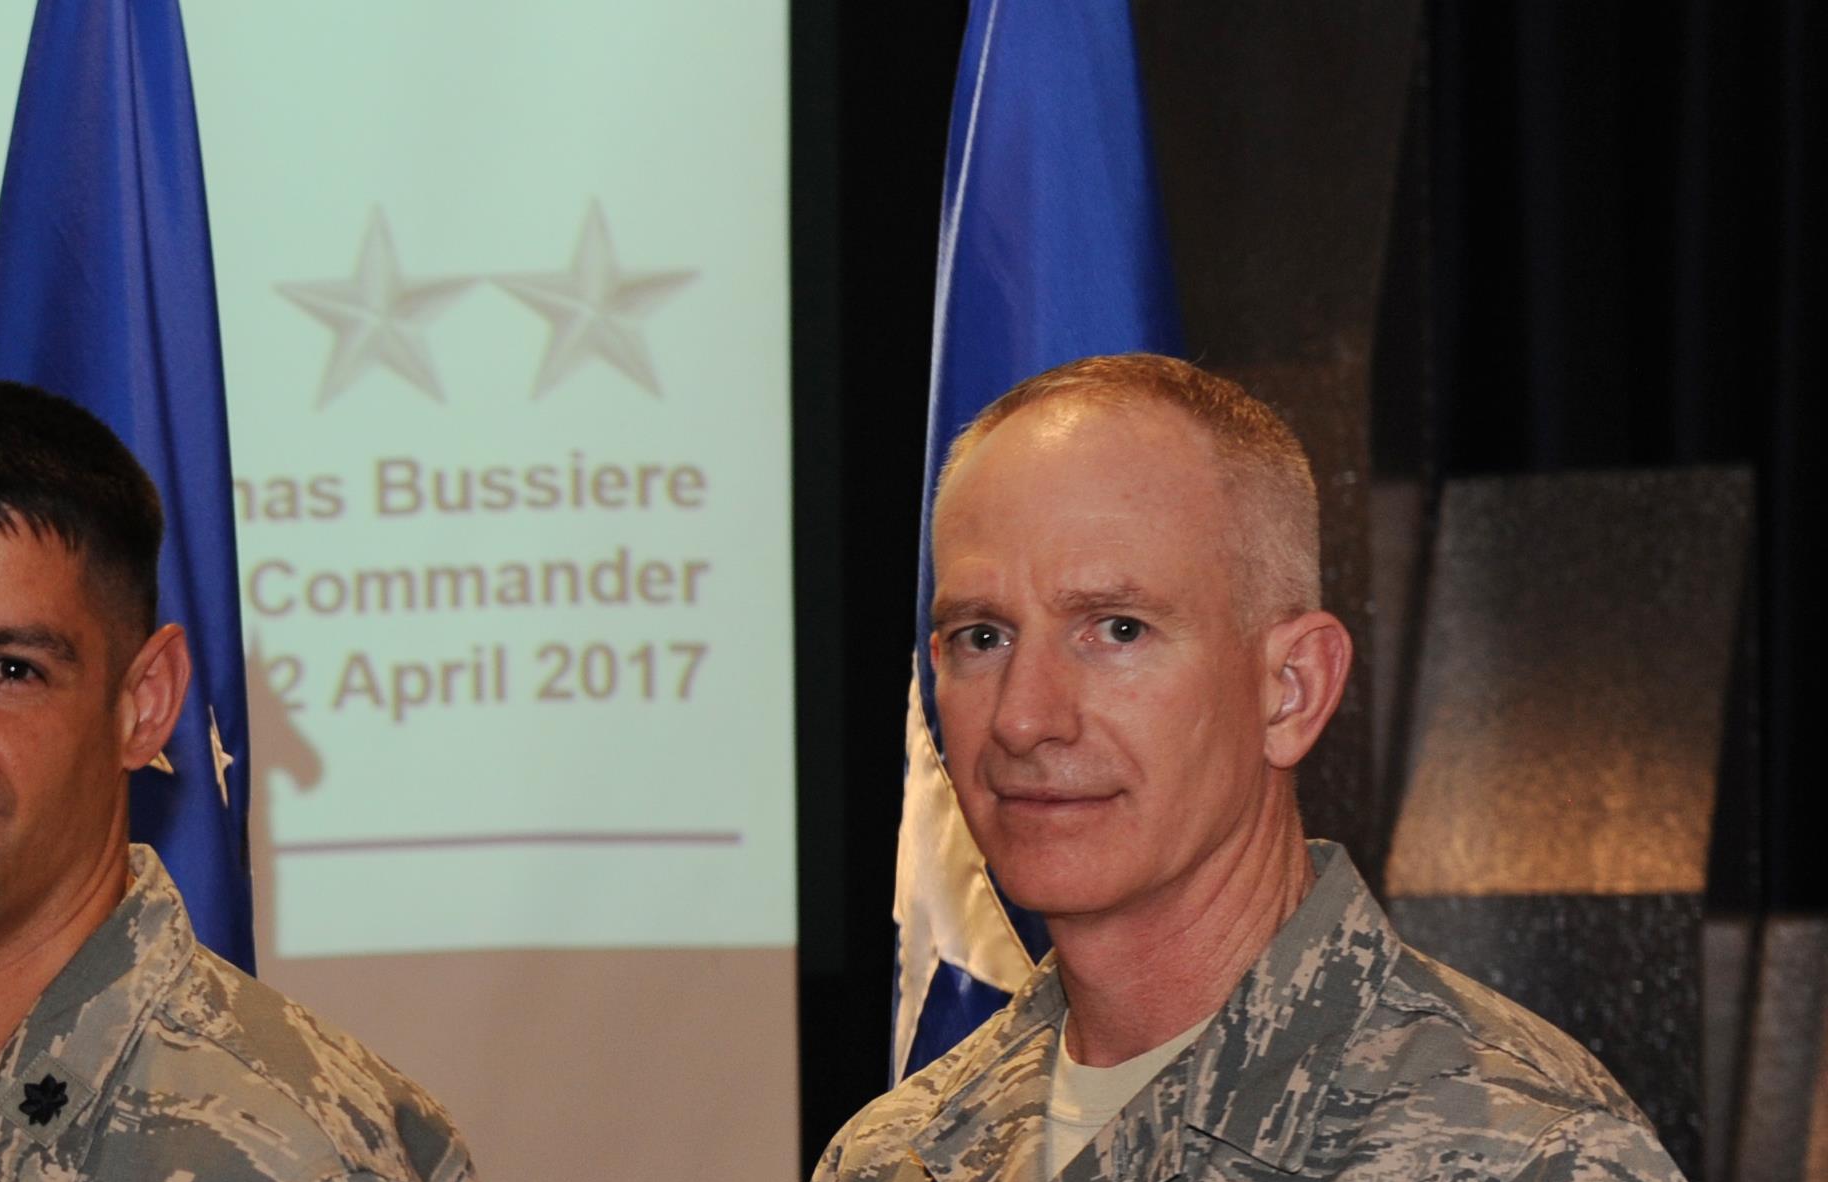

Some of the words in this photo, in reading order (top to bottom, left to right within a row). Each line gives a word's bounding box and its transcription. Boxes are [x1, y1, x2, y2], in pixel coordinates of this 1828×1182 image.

[375, 449, 709, 518] Bussiere
[245, 546, 712, 618] Commander
[331, 644, 509, 726] April
[535, 640, 710, 702] 2017
